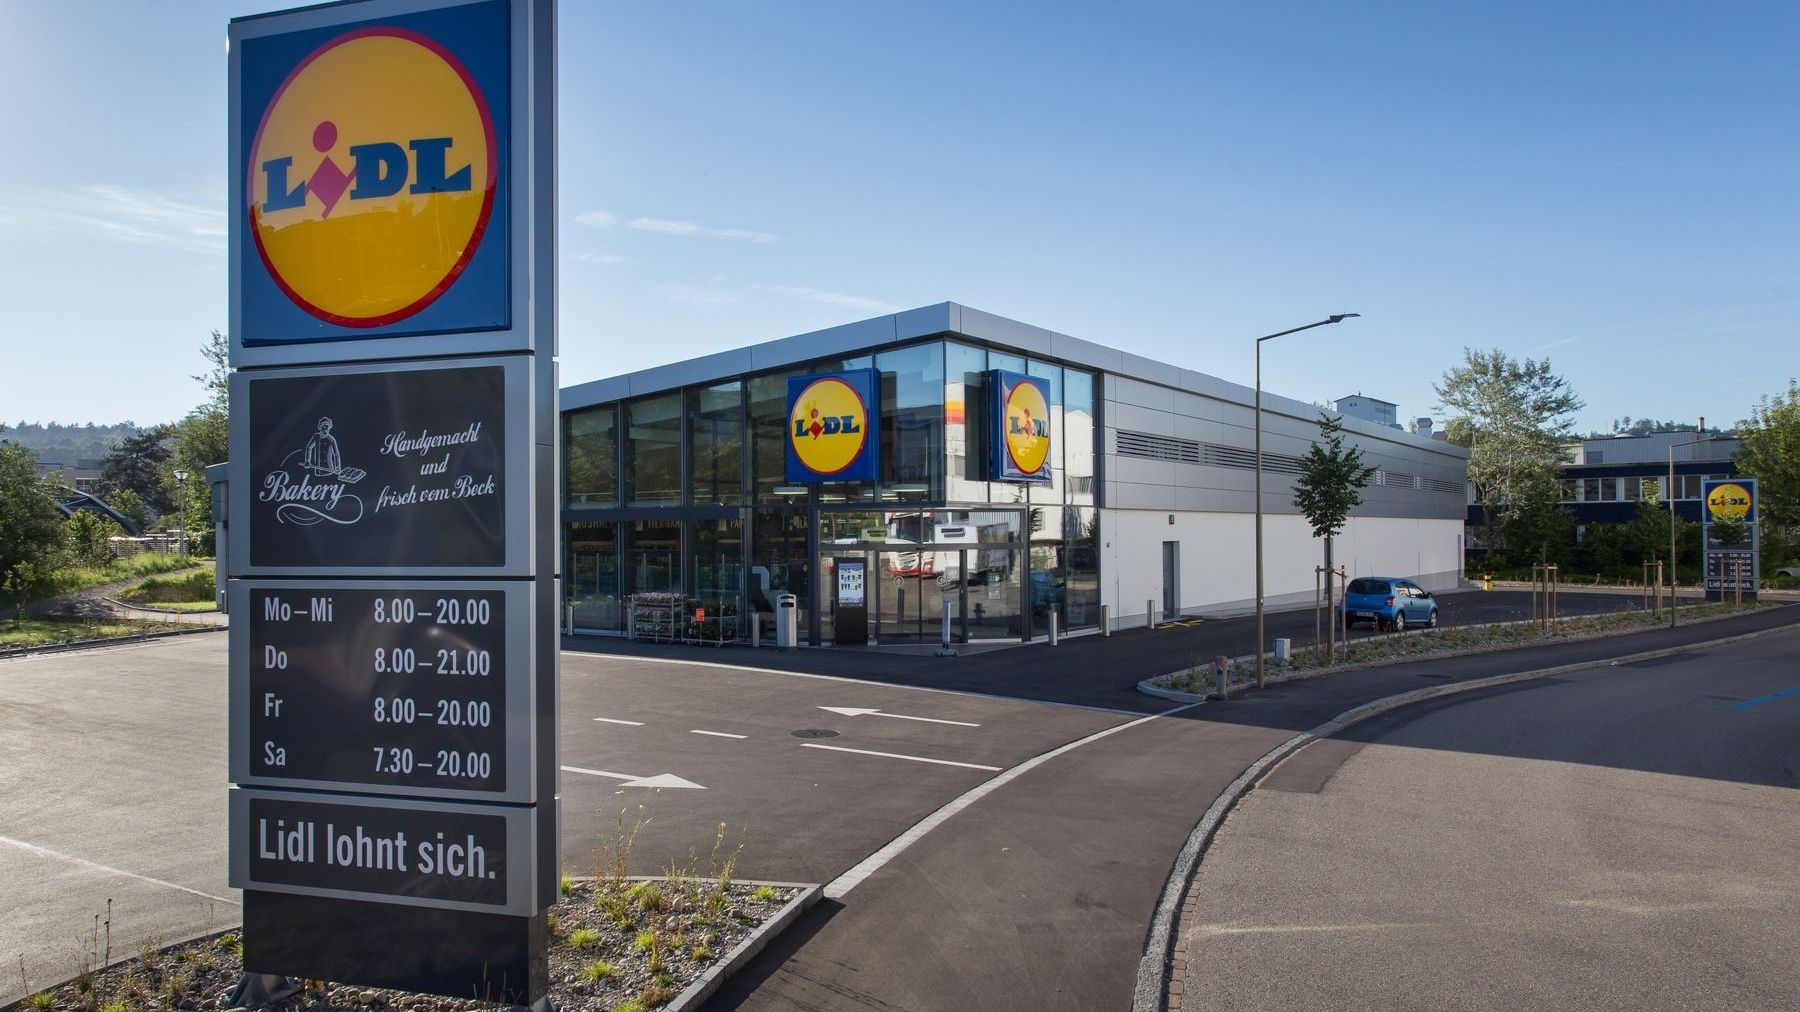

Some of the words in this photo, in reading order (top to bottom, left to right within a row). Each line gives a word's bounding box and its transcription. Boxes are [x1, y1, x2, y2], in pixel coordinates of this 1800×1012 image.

[380, 421, 482, 457] Handgemacht
[420, 453, 450, 476] und
[259, 470, 345, 511] Bakery
[375, 485, 416, 513] frisch
[419, 486, 451, 503] vom
[451, 474, 495, 499] Beck
[264, 645, 288, 670] Do
[264, 693, 283, 717] Fr
[264, 740, 286, 766] Sa
[260, 818, 314, 863] Lidl
[327, 823, 407, 872] lohnt
[417, 832, 496, 880] sich.
